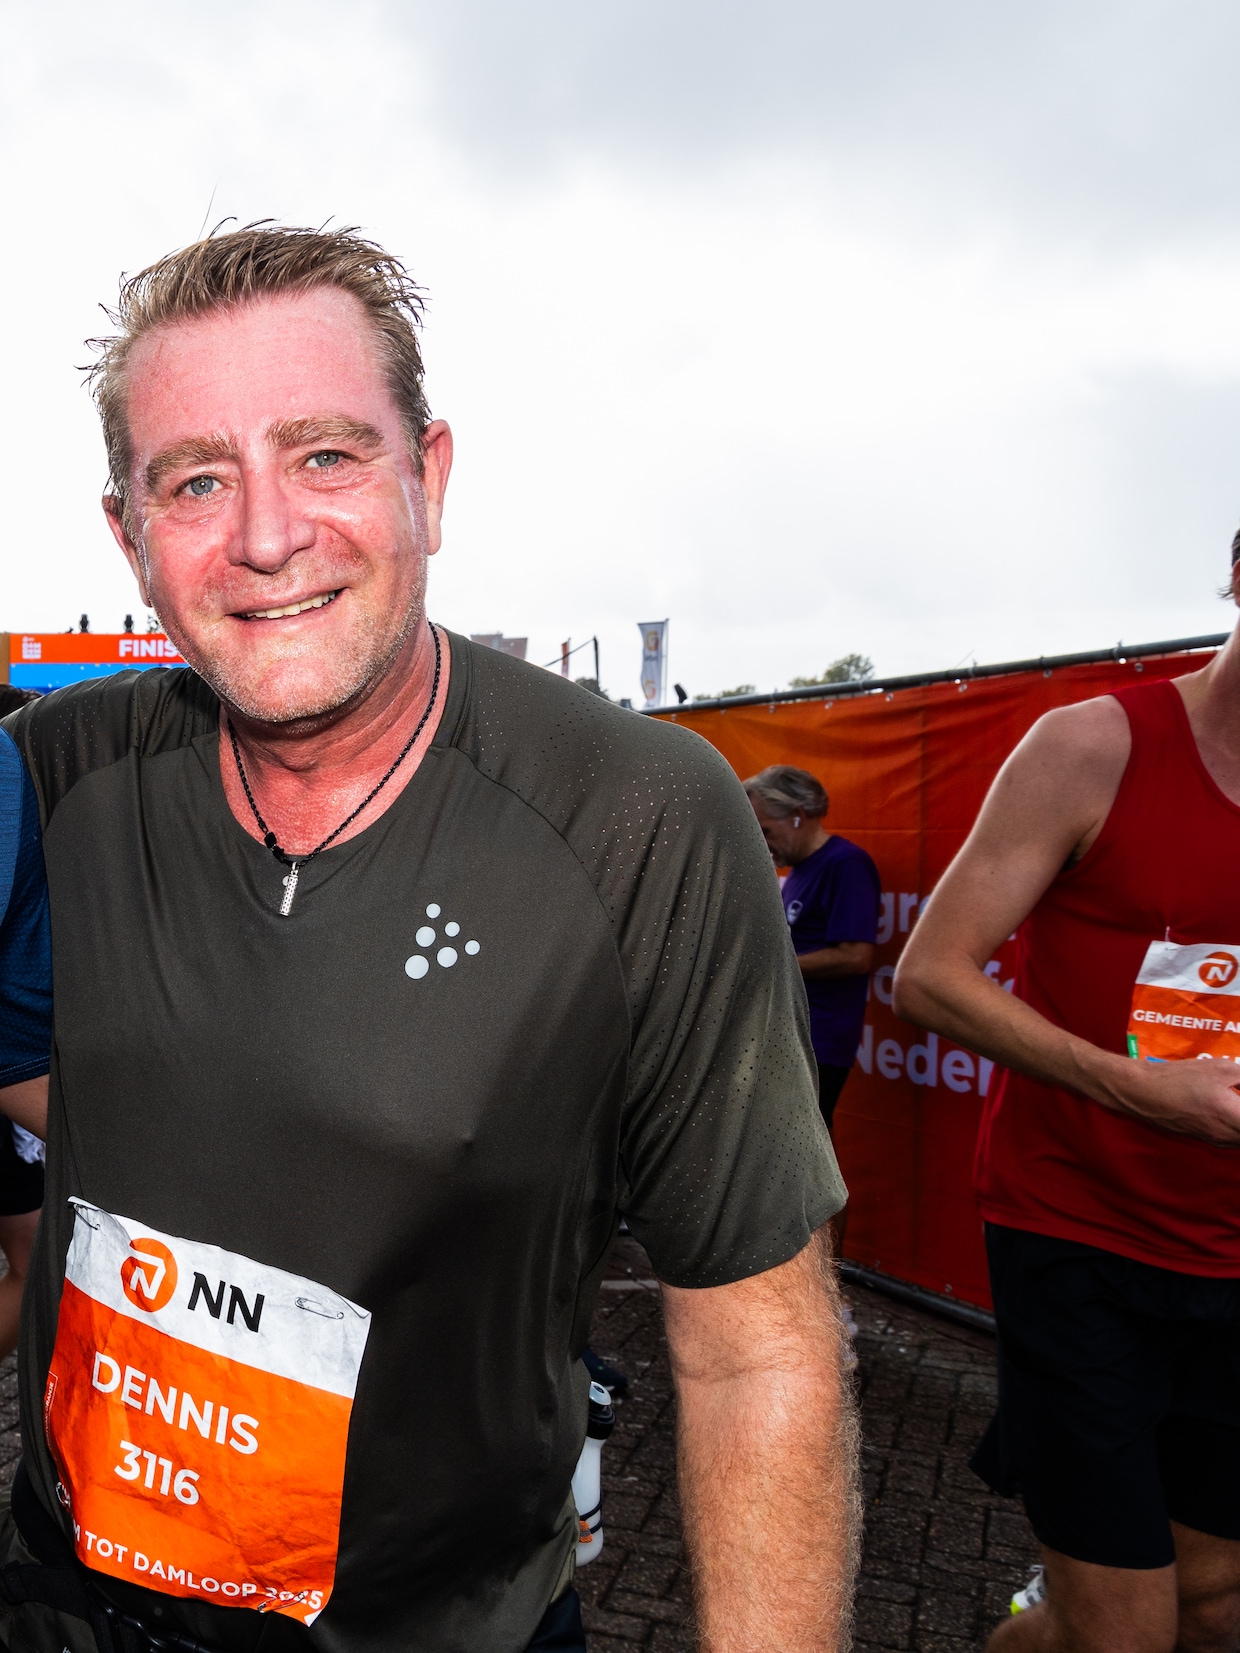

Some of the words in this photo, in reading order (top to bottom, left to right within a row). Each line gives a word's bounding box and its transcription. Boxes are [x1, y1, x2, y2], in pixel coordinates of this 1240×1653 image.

[119, 639, 180, 658] FINIS
[1133, 1009, 1223, 1031] GEMEENTE
[187, 1271, 265, 1333] NN
[91, 1350, 259, 1455] DENNIS
[113, 1440, 201, 1506] 3116
[85, 1530, 128, 1563] TOT
[133, 1552, 257, 1598] DAMLOOP
